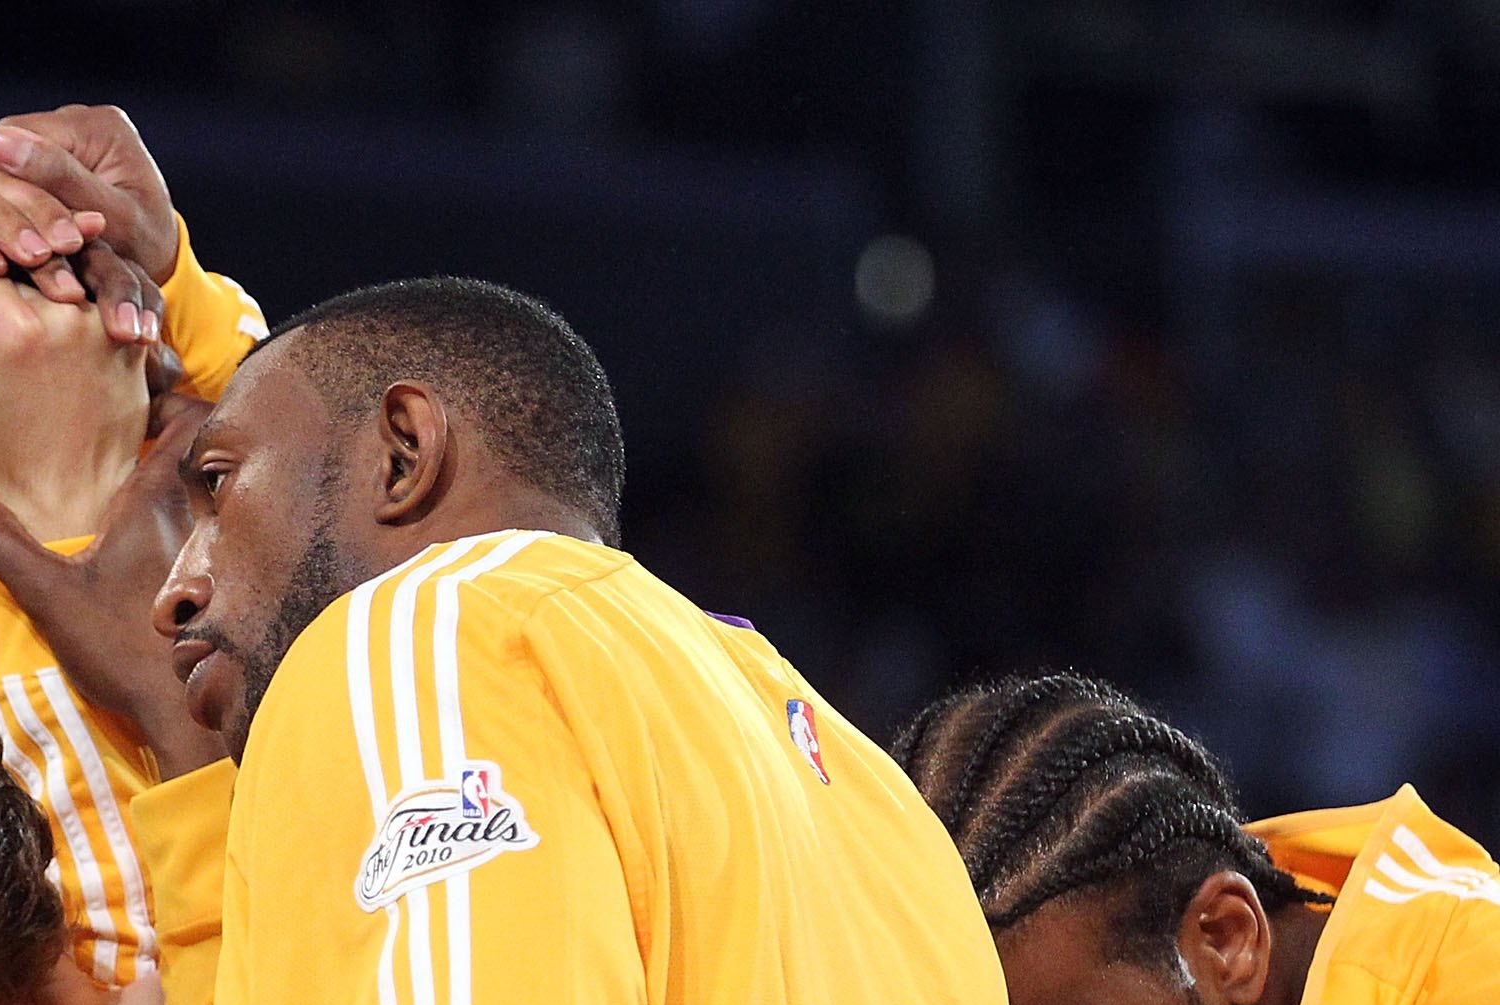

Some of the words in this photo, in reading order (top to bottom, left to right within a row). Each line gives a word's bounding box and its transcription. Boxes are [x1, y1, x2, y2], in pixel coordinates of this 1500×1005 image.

[361, 806, 528, 899] Finals
[364, 844, 391, 892] The
[402, 846, 453, 872] 2010
